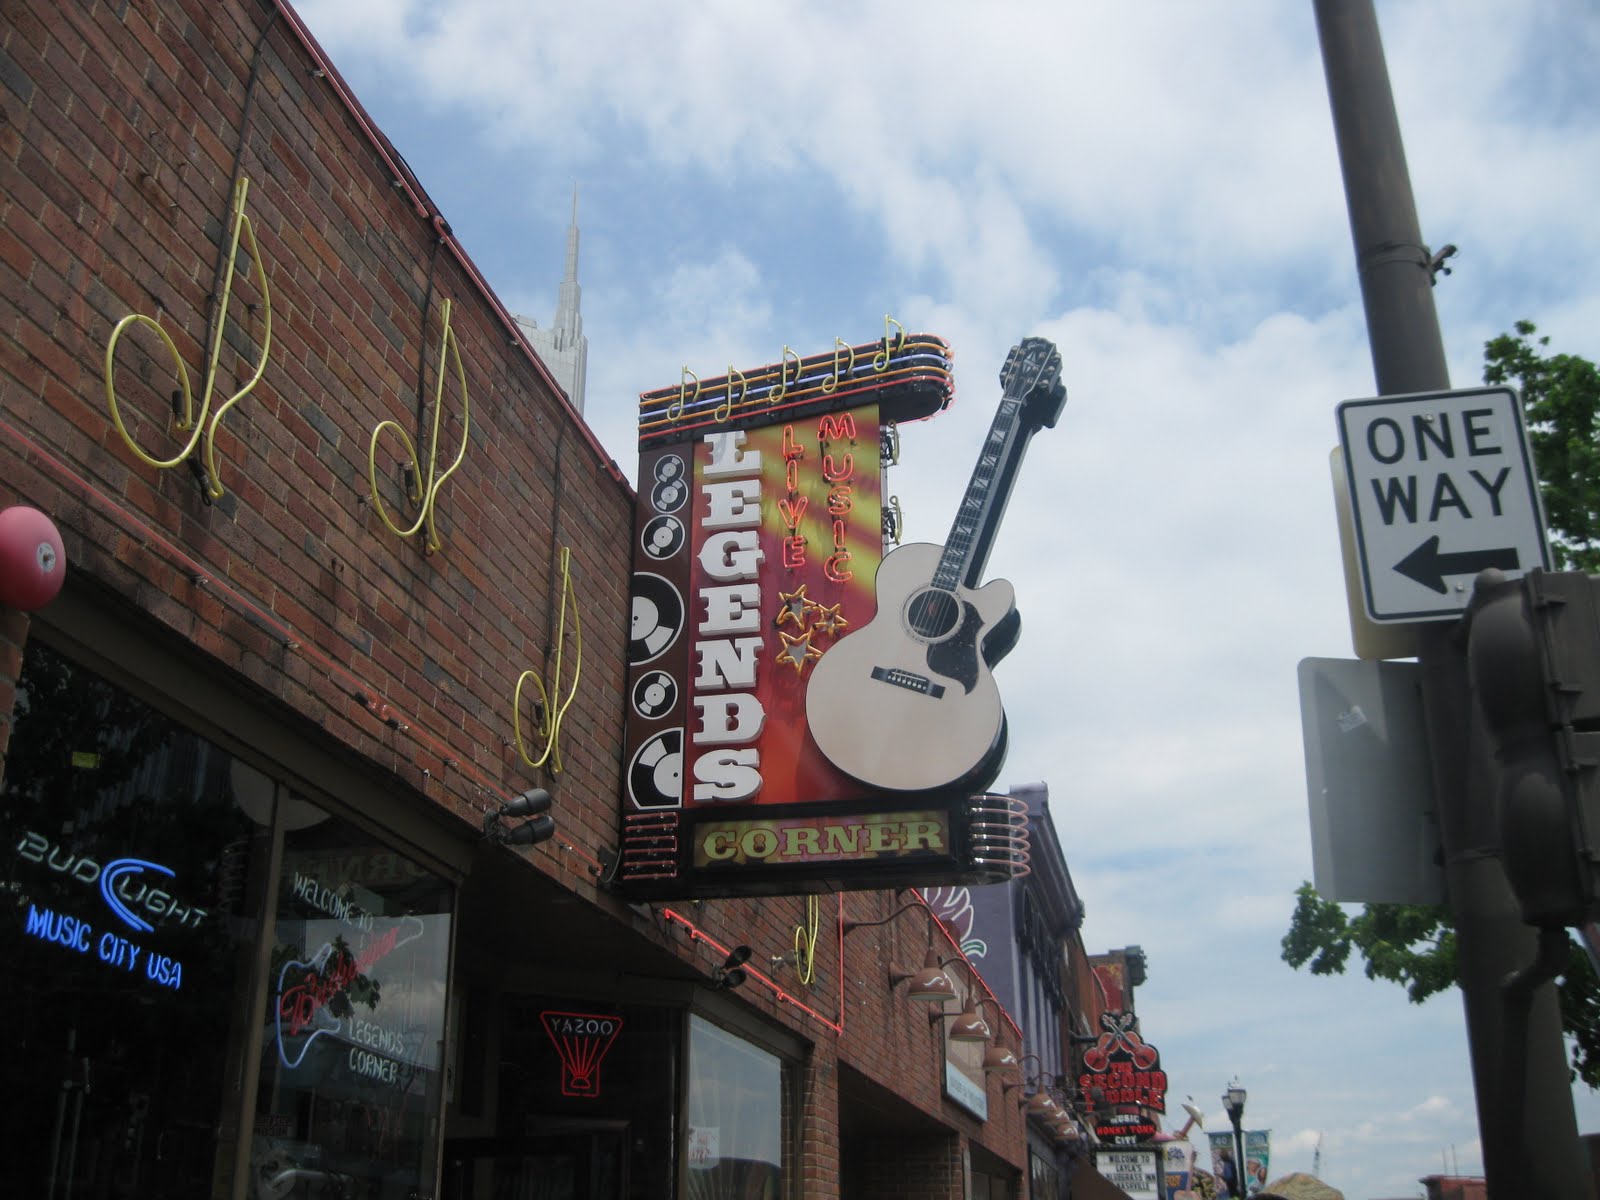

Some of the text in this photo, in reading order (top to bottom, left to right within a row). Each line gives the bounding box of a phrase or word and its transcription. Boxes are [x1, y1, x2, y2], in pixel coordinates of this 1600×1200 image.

[1367, 408, 1502, 464] ONE
[777, 425, 809, 570] LIVE
[817, 413, 856, 583] MUSIC
[1371, 467, 1513, 525] WAY
[693, 431, 766, 802] LEGENDS
[702, 821, 945, 860] CORNER
[17, 830, 208, 928] BUD LIGHT
[292, 872, 374, 933] WELCOME TO
[26, 903, 183, 991] MUSIC CITY USA
[348, 1018, 404, 1054] LEGENDS
[551, 1017, 613, 1035] YAZOO
[349, 1047, 400, 1085] CORNER
[1080, 1071, 1166, 1091] SECOND
[1110, 1062, 1133, 1072] THE
[1096, 1125, 1155, 1135] HONKY TONK
[1115, 1136, 1136, 1144] CITY
[1109, 1155, 1150, 1163] WELCOME TO
[1116, 1164, 1142, 1172] LAYLA'S
